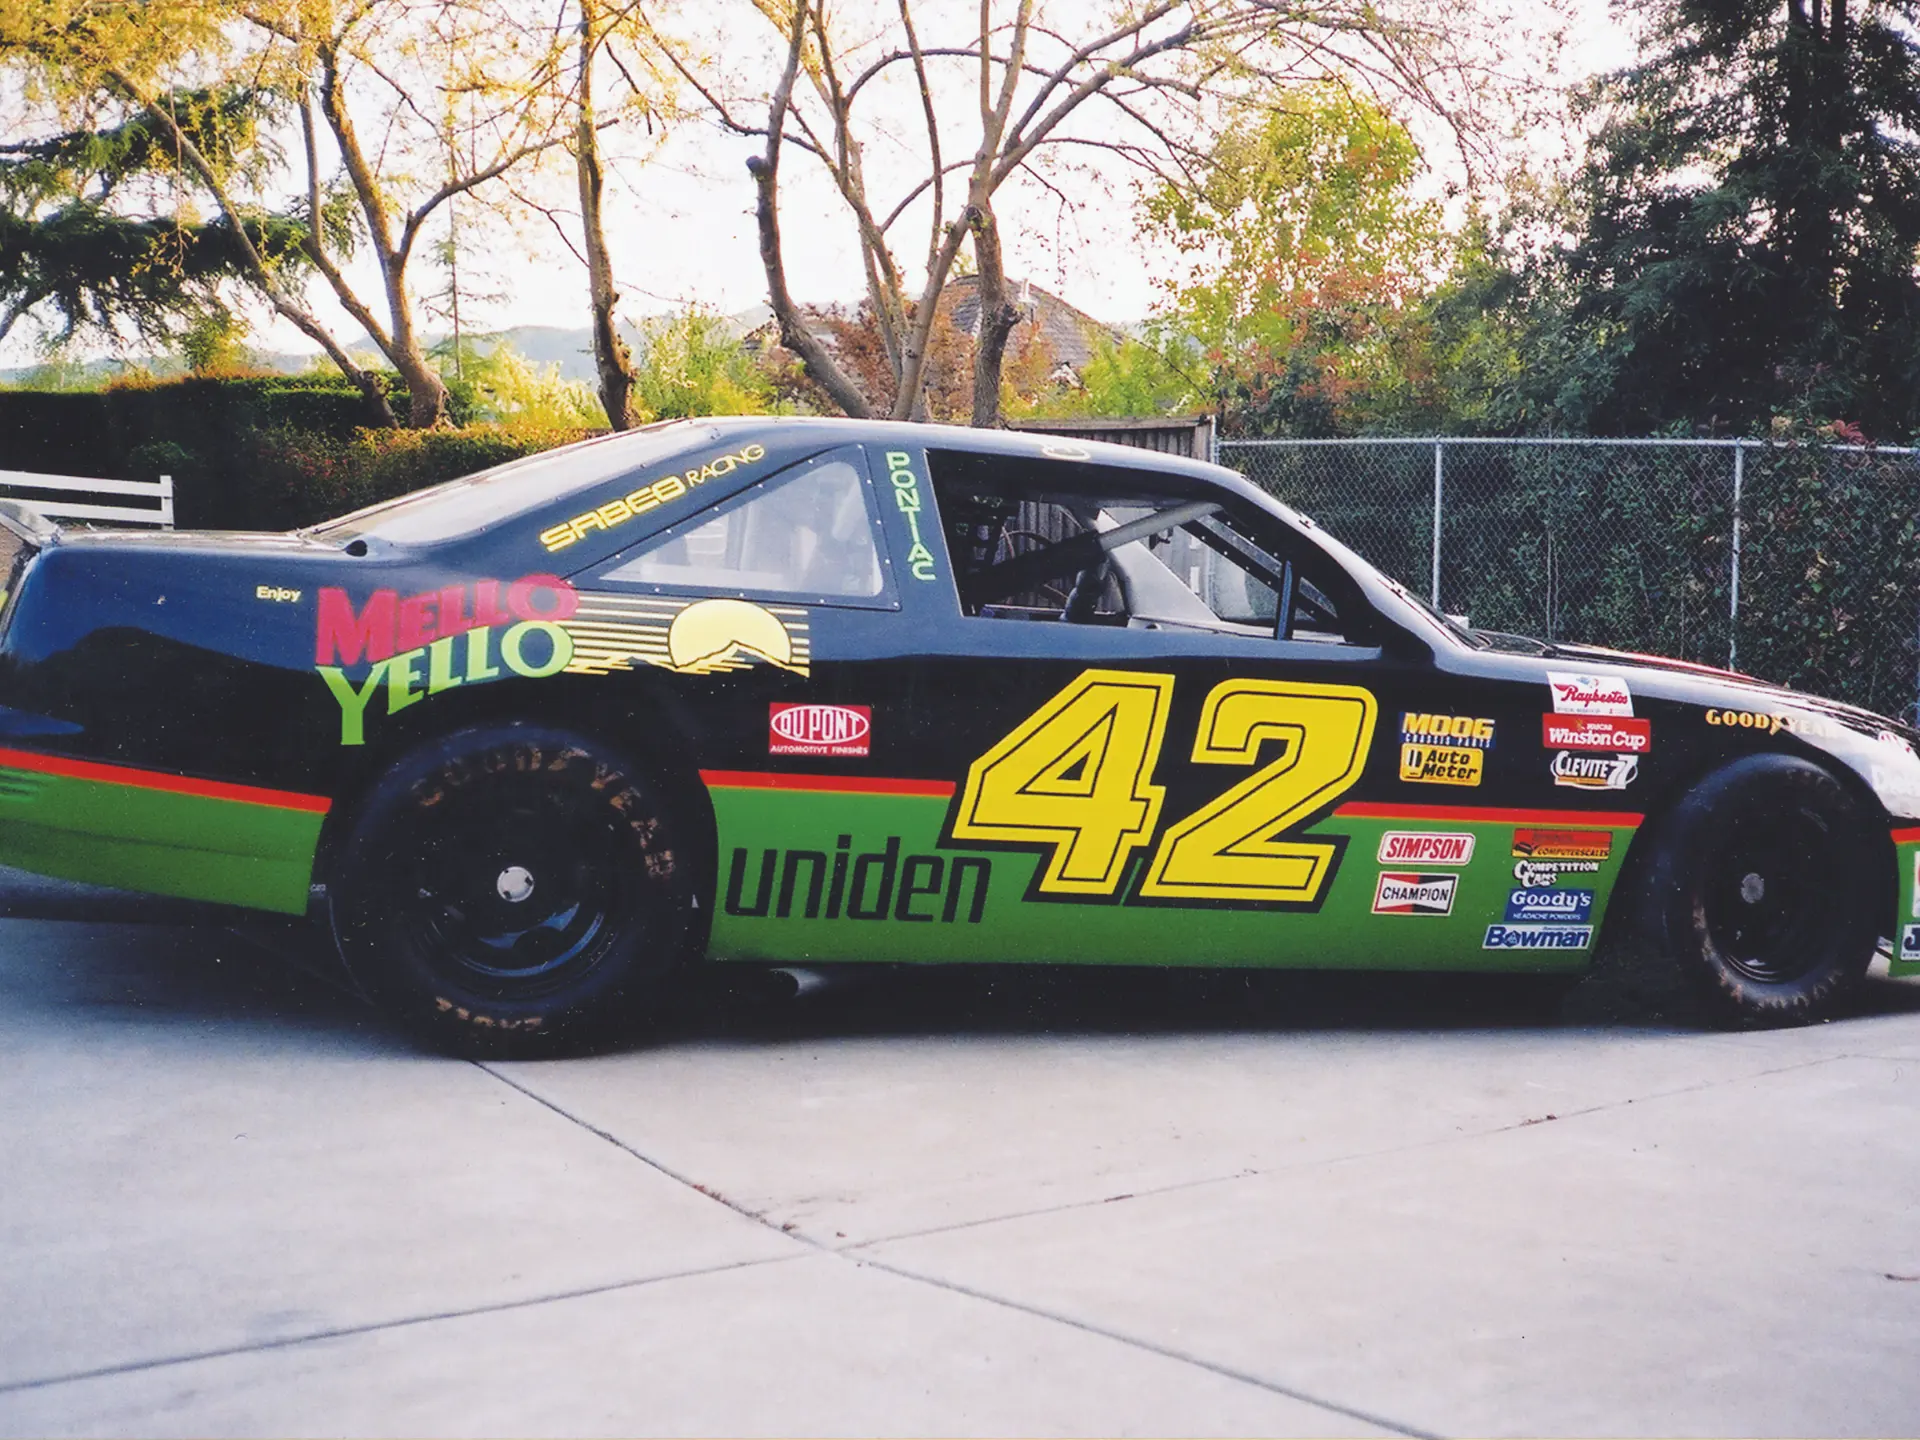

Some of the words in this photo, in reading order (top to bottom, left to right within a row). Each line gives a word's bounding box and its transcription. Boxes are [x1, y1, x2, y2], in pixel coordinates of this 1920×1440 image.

[685, 444, 765, 488] RACING
[884, 451, 937, 582] PONTIAC
[256, 585, 302, 603] Enjoy
[316, 573, 579, 666] MELLO
[315, 620, 574, 745] YELLO
[1553, 683, 1629, 708] Raybestos
[1402, 711, 1496, 741] MOOG
[770, 744, 828, 754] AUTOMOTIVE
[831, 746, 869, 756] FINISHES
[1549, 727, 1612, 746] Winston
[1612, 731, 1647, 751] Cup
[1426, 749, 1470, 765] Auto
[1555, 750, 1609, 778] CLEVITE
[1420, 763, 1478, 779] Meter
[951, 668, 1379, 902] 42
[1385, 837, 1467, 860] SIMPSON
[724, 834, 992, 924] uniden
[1514, 859, 1600, 879] COMPETITION
[1382, 886, 1449, 901] CHAMPION
[1511, 890, 1591, 911] Goody's
[1485, 926, 1590, 948] Bowman
